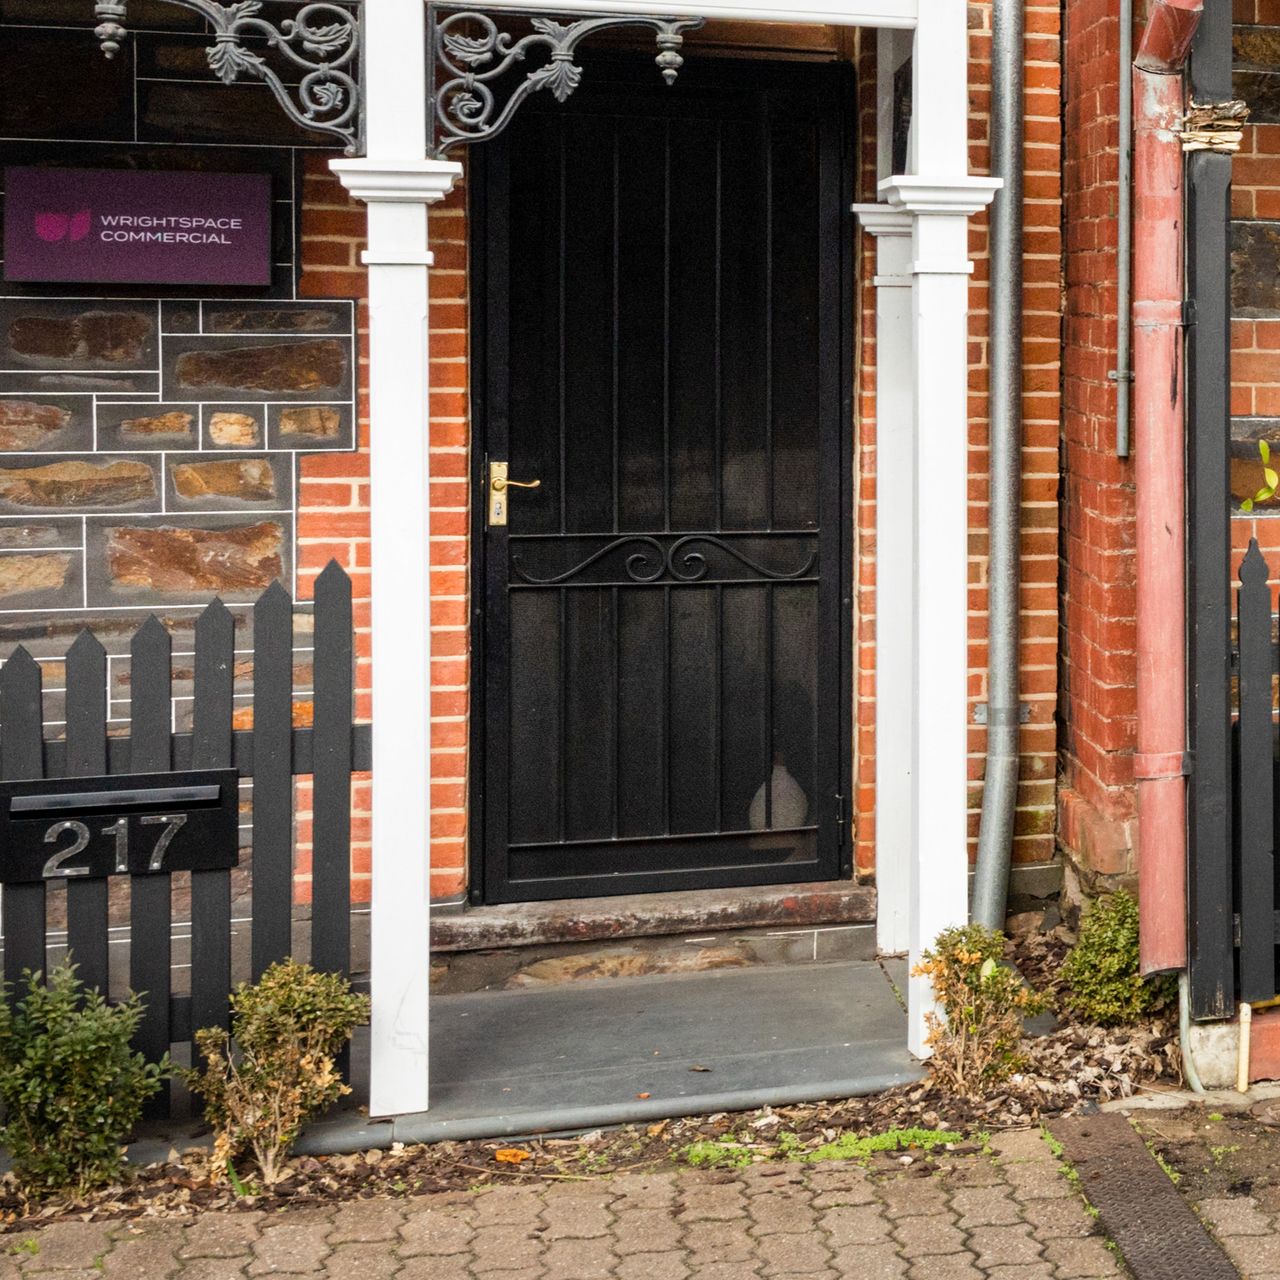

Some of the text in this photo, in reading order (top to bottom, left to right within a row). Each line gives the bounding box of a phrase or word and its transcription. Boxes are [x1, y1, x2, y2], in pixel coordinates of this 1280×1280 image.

[101, 215, 242, 229] WRIGHTSPACE
[101, 231, 232, 244] COMMERCIAL
[42, 814, 188, 878] 217
